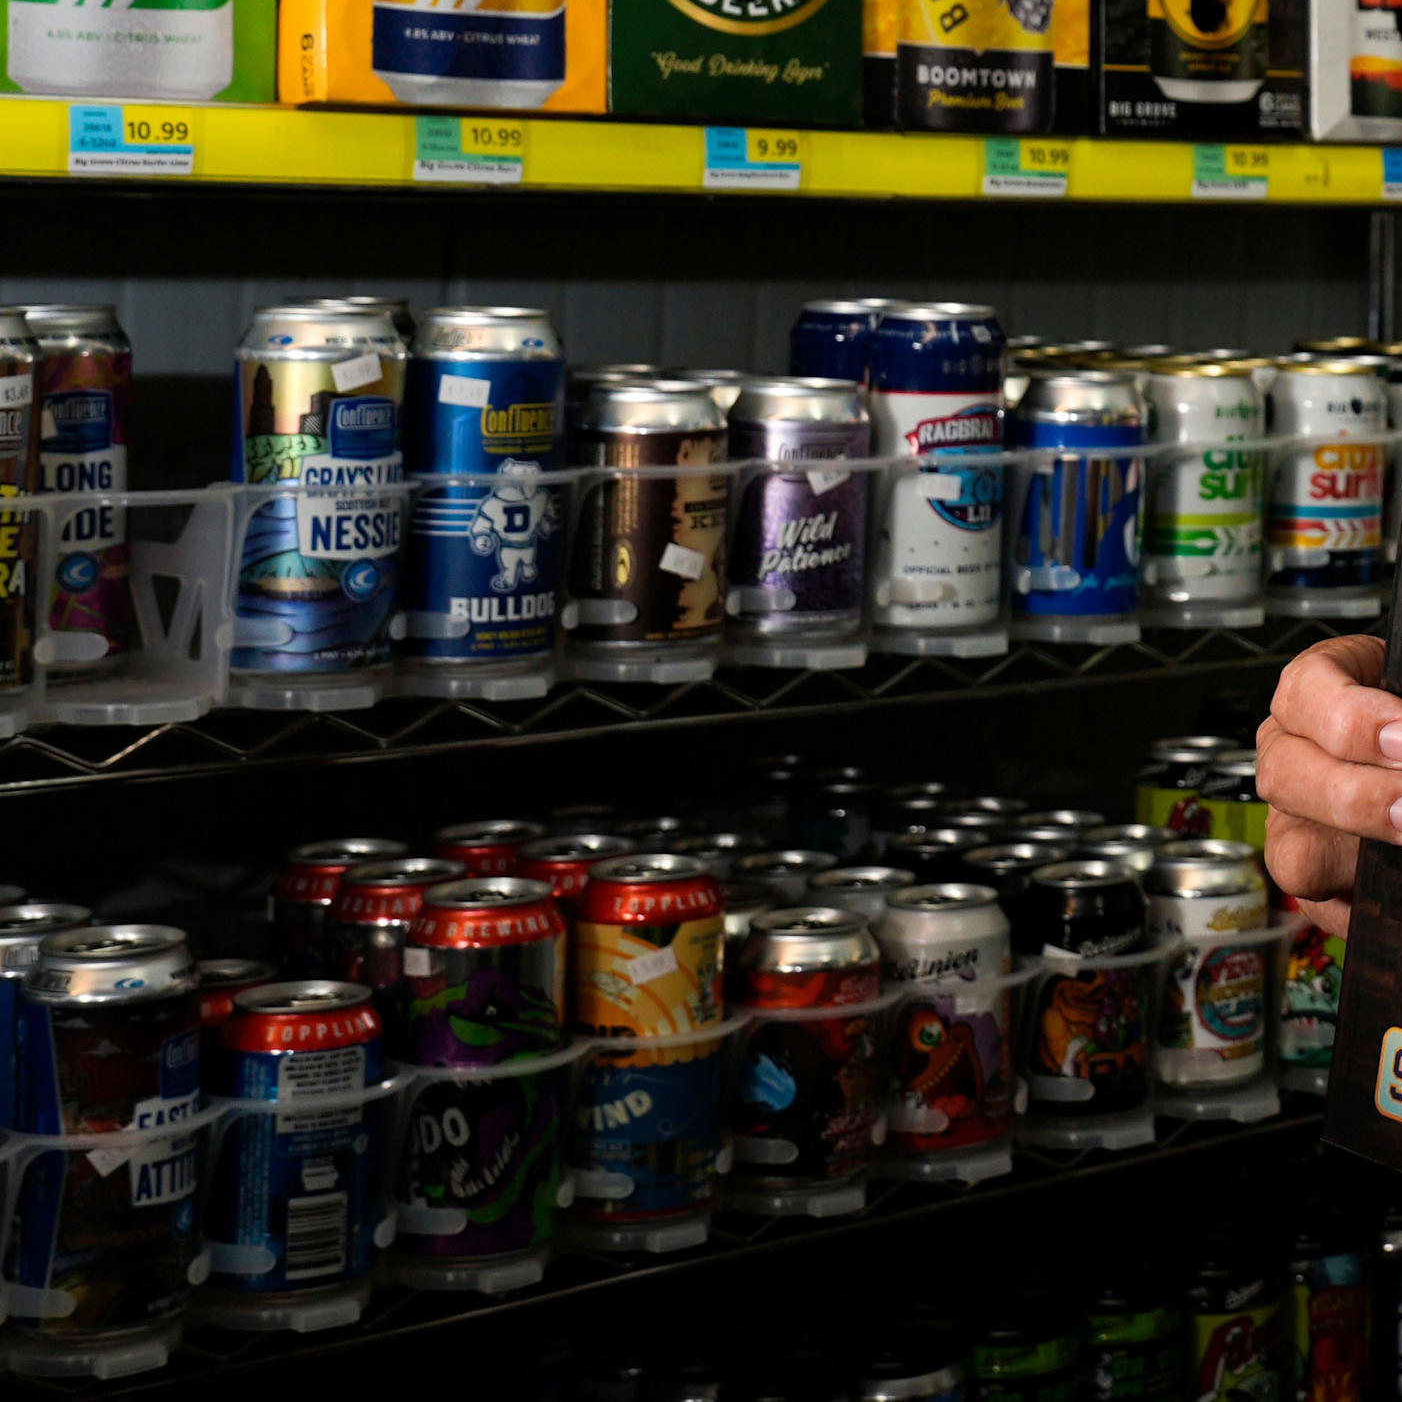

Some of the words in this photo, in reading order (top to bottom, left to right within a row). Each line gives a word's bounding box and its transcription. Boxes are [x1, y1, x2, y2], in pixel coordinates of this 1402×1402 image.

[916, 64, 1037, 89] BOOMTOWN
[127, 121, 188, 141] 10.99
[472, 127, 522, 147] 10.99
[757, 139, 797, 157] 9.99
[41, 461, 112, 490] LONG
[311, 515, 399, 552] NESSIE
